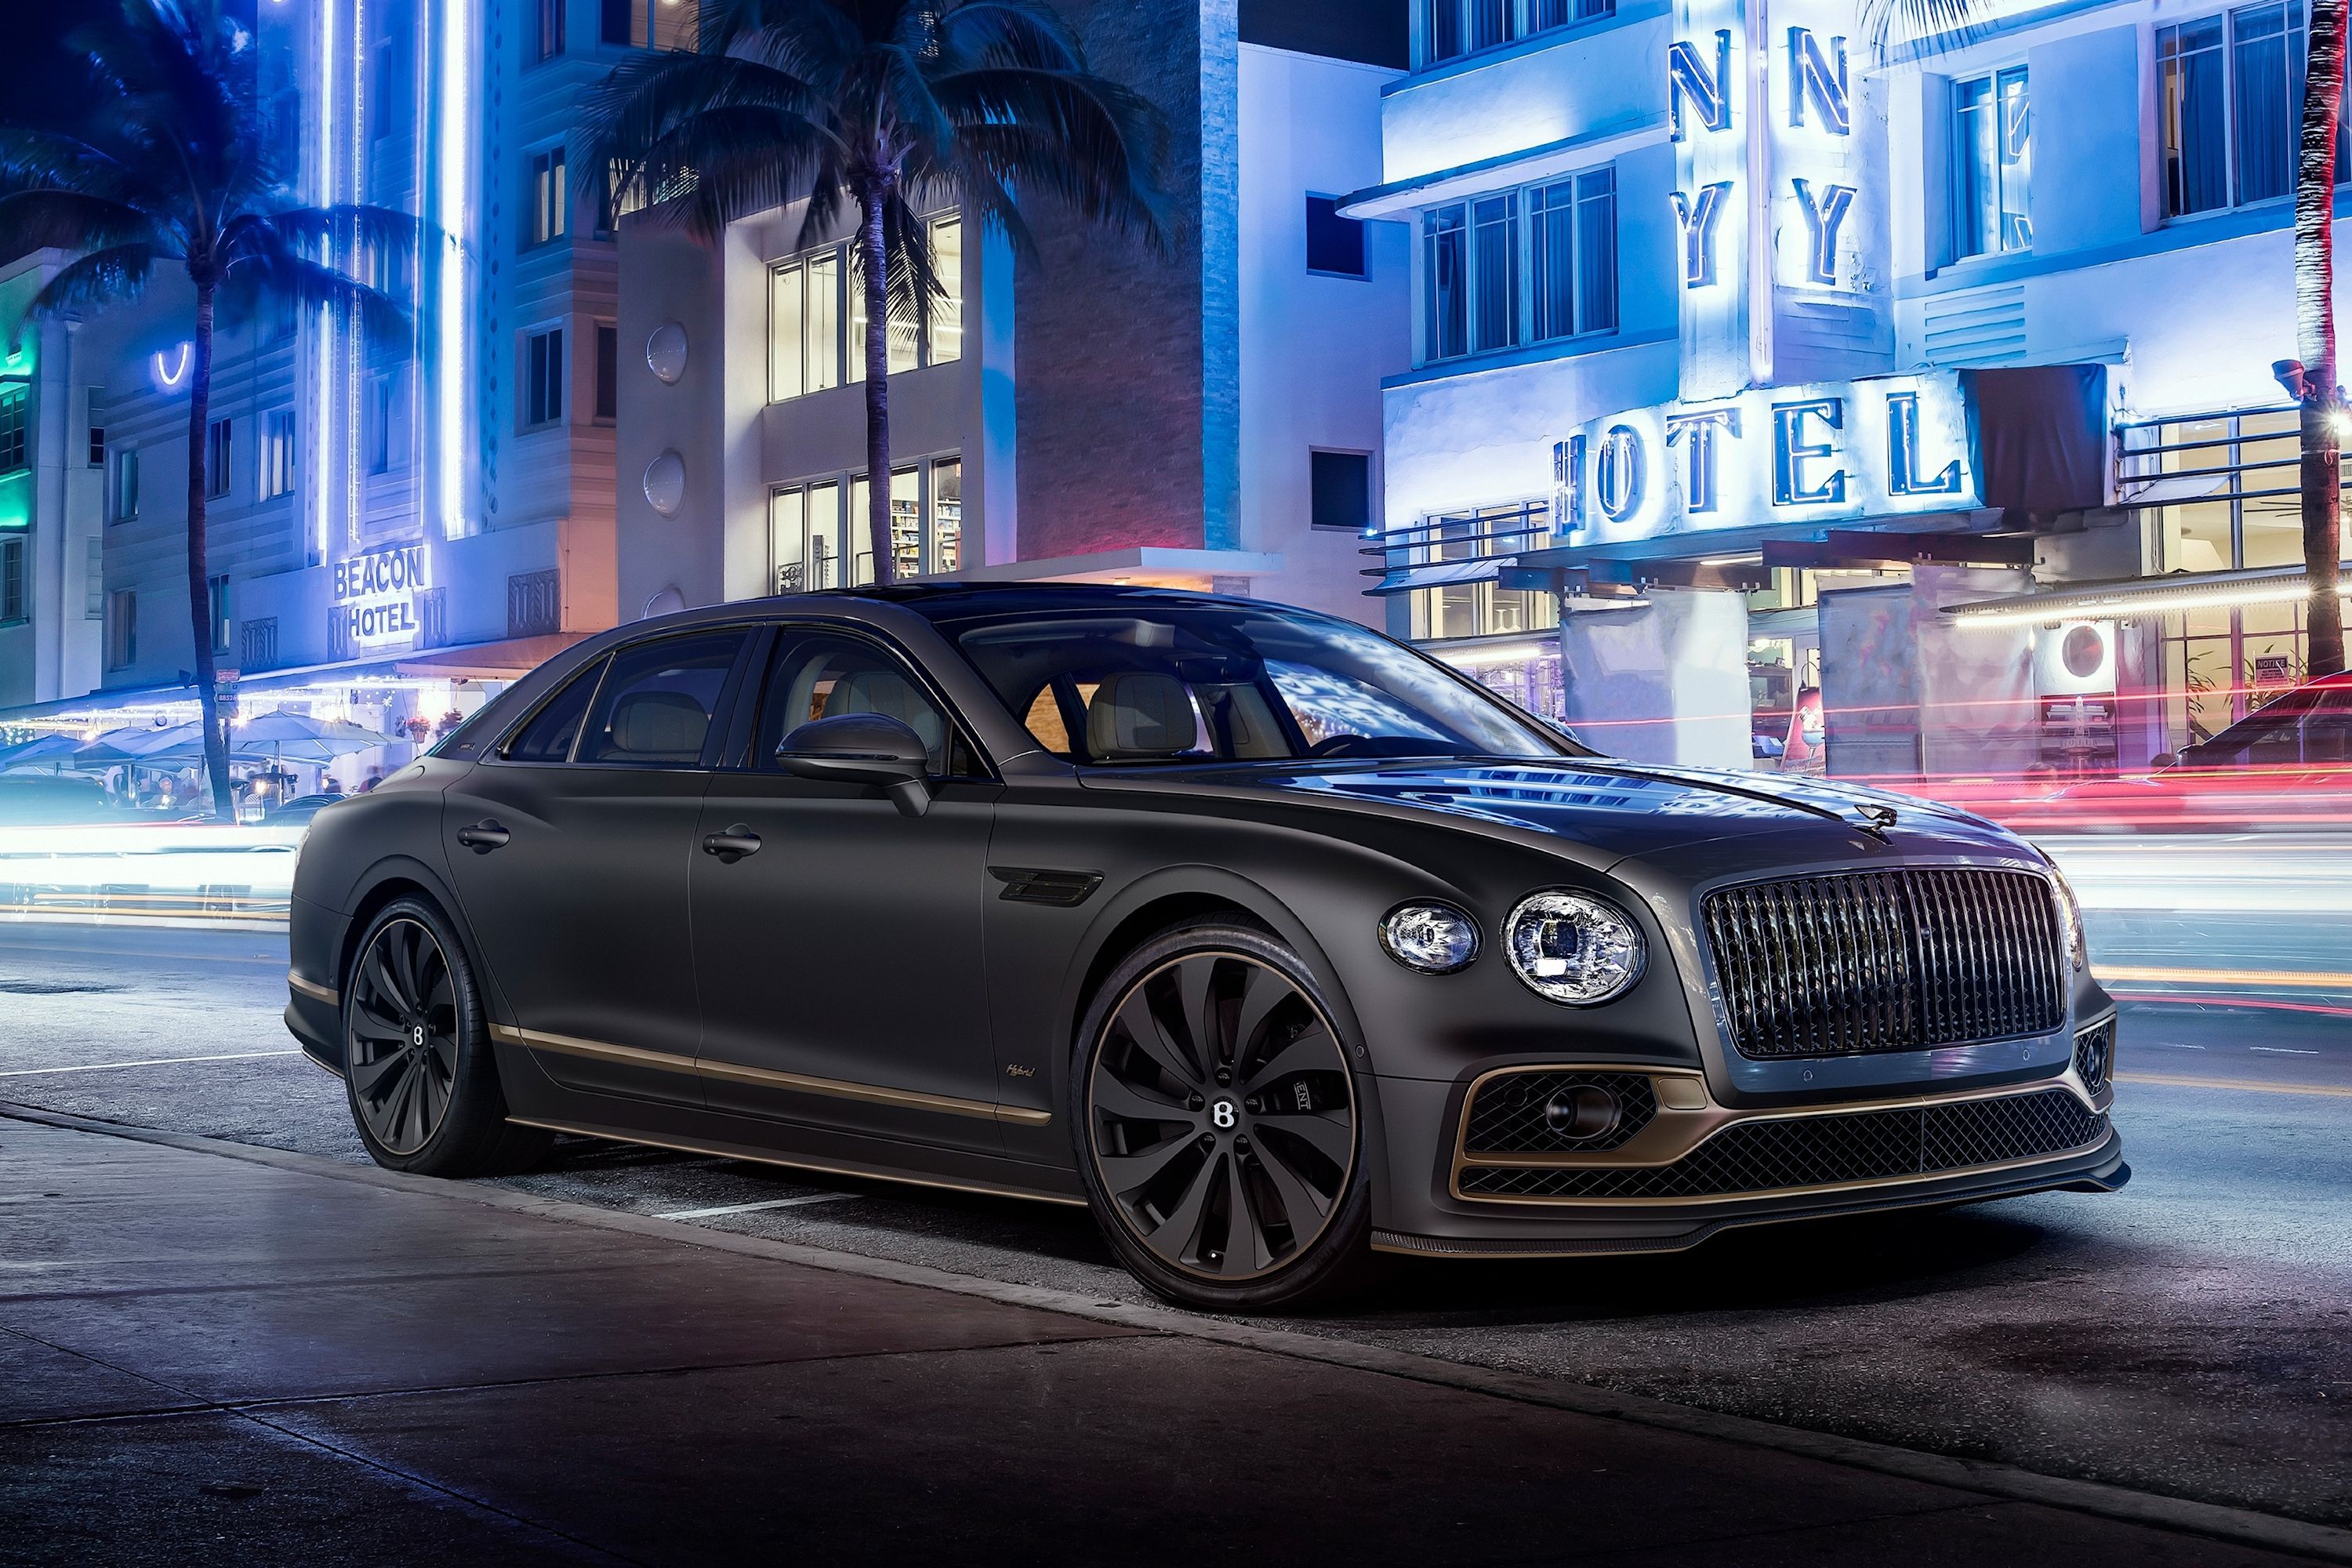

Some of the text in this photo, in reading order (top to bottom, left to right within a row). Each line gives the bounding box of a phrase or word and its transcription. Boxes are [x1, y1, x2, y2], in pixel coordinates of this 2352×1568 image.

[1548, 390, 1962, 537] HOTEL
[334, 547, 425, 601] BEACON
[349, 602, 416, 637] HOTEL
[1006, 1063, 1035, 1076] Hybrid
[1296, 1082, 1308, 1109] ENT
[1213, 1101, 1235, 1127] B
